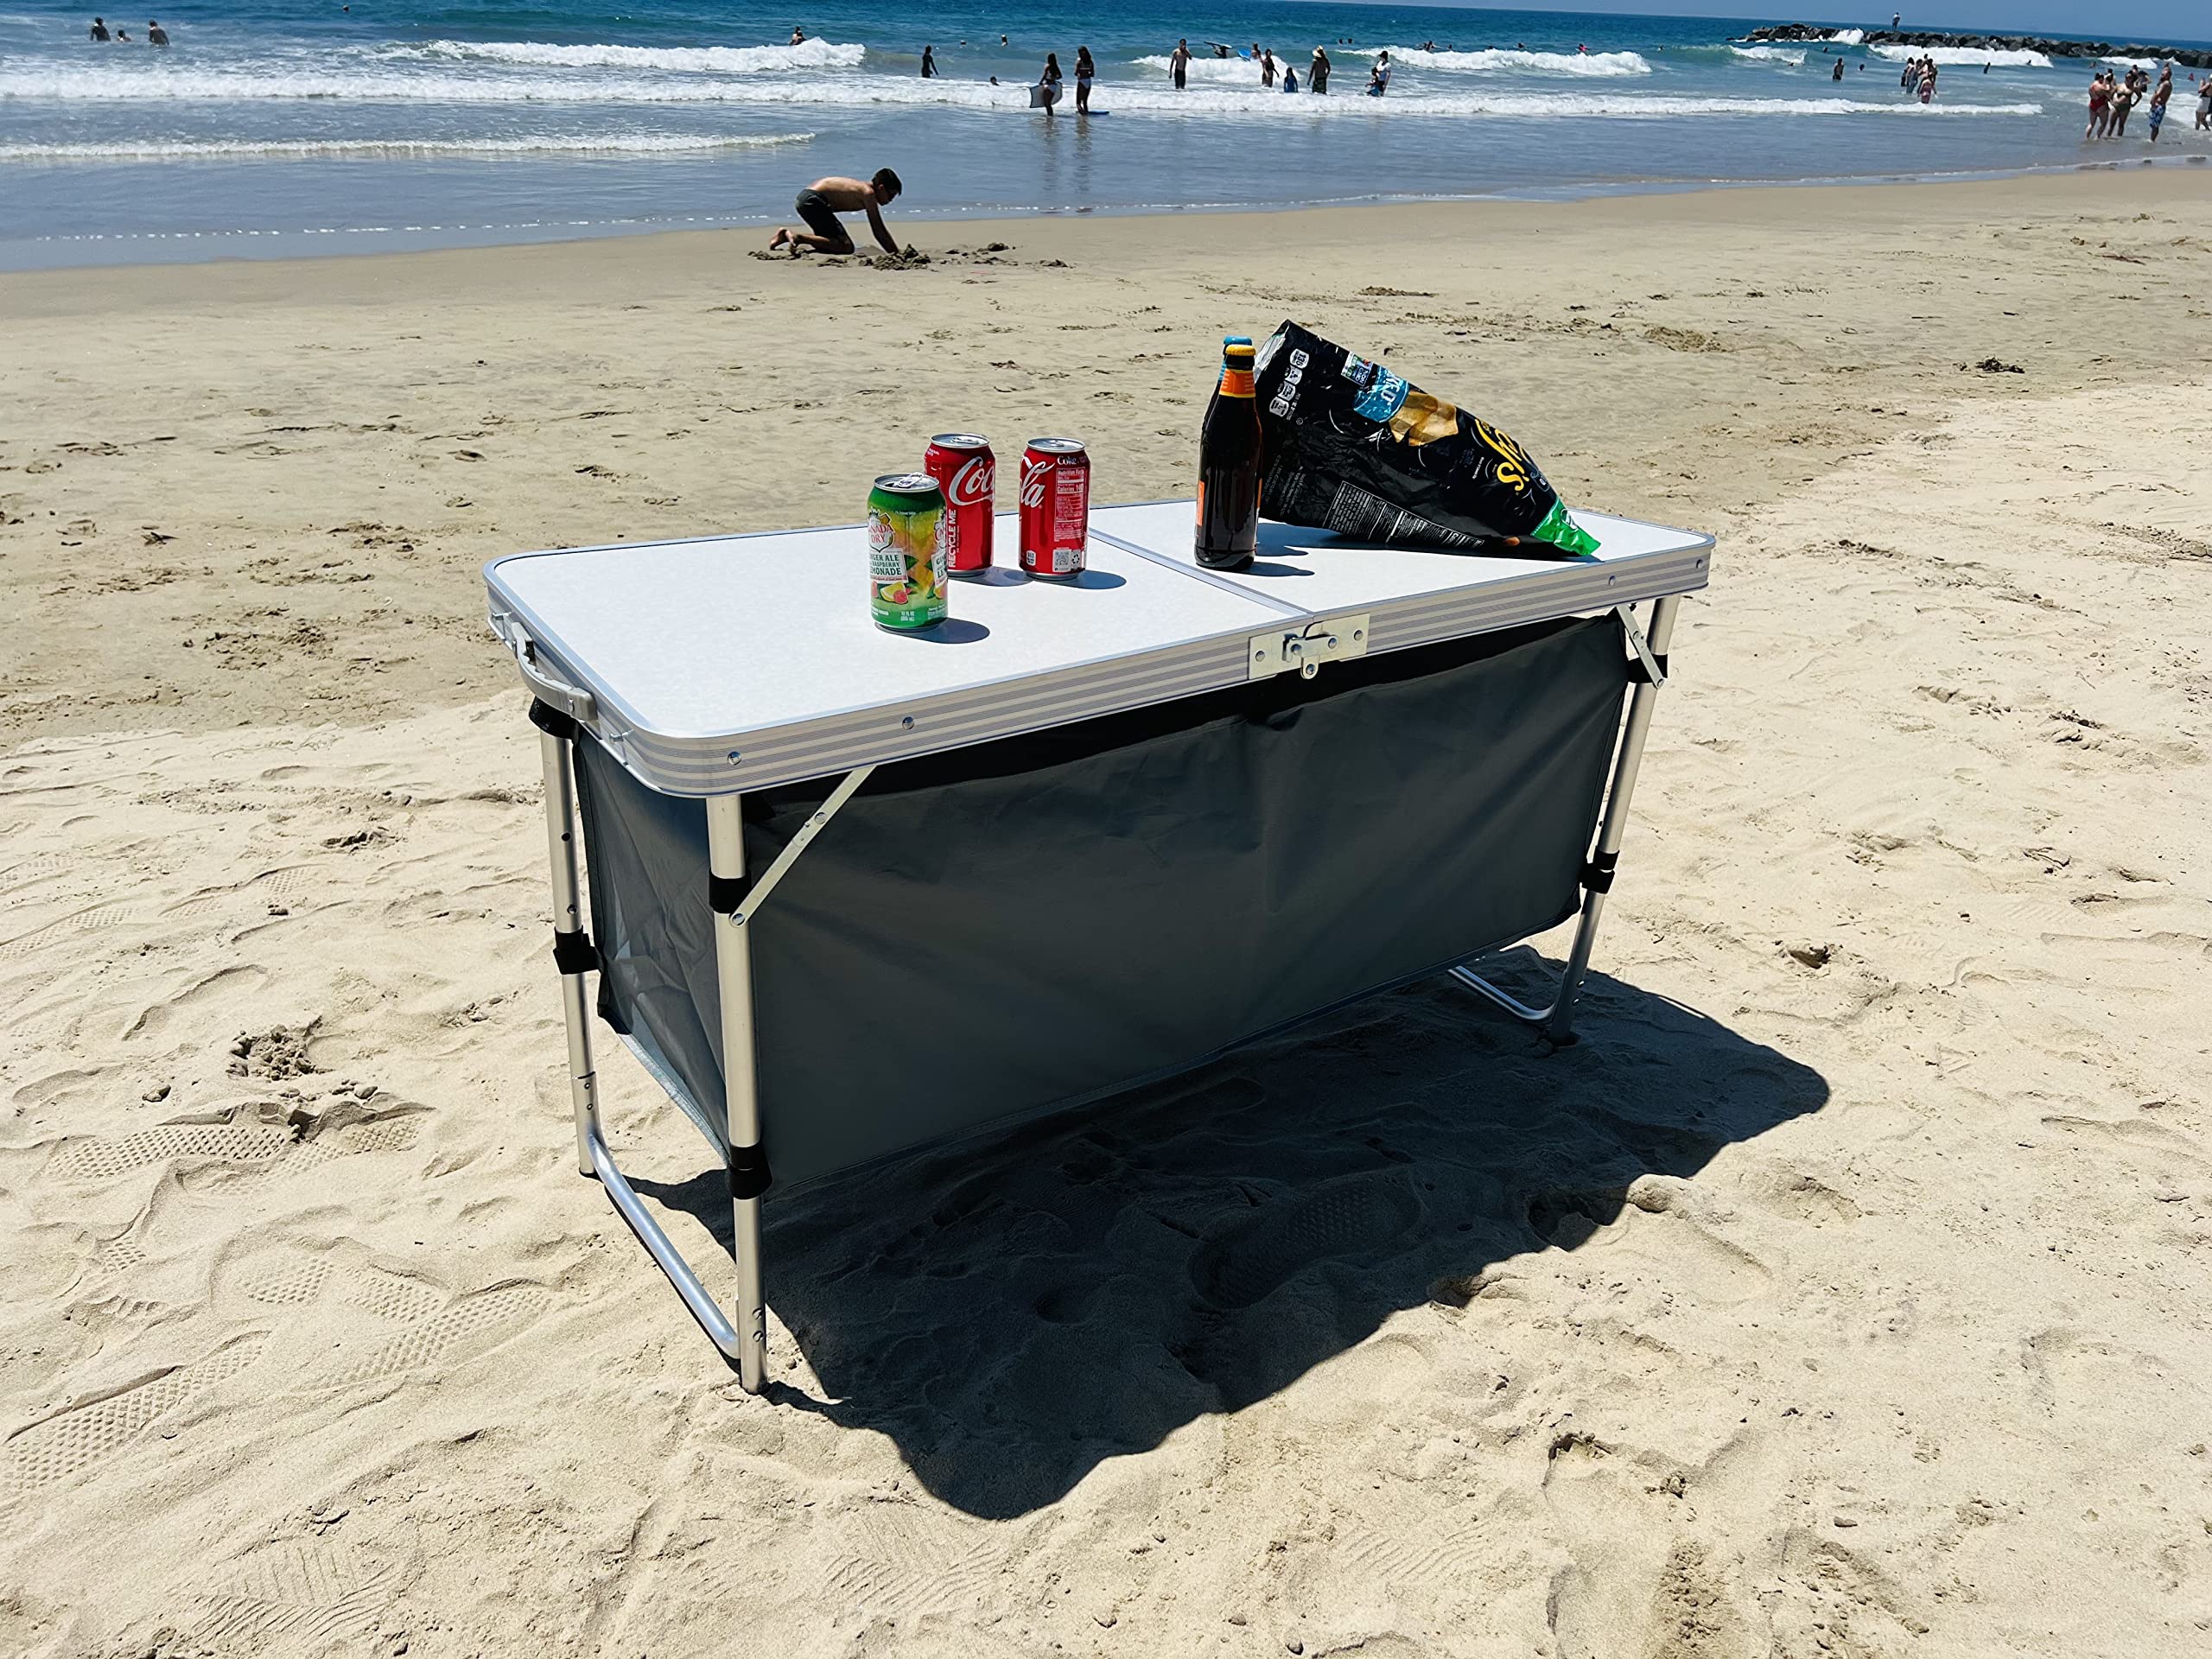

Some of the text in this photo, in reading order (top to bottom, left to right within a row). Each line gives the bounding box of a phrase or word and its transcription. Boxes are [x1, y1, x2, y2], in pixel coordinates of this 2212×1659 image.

[1057, 455, 1077, 465] Coke
[871, 534, 885, 543] DRY
[948, 509, 957, 568] RECYCLE ME
